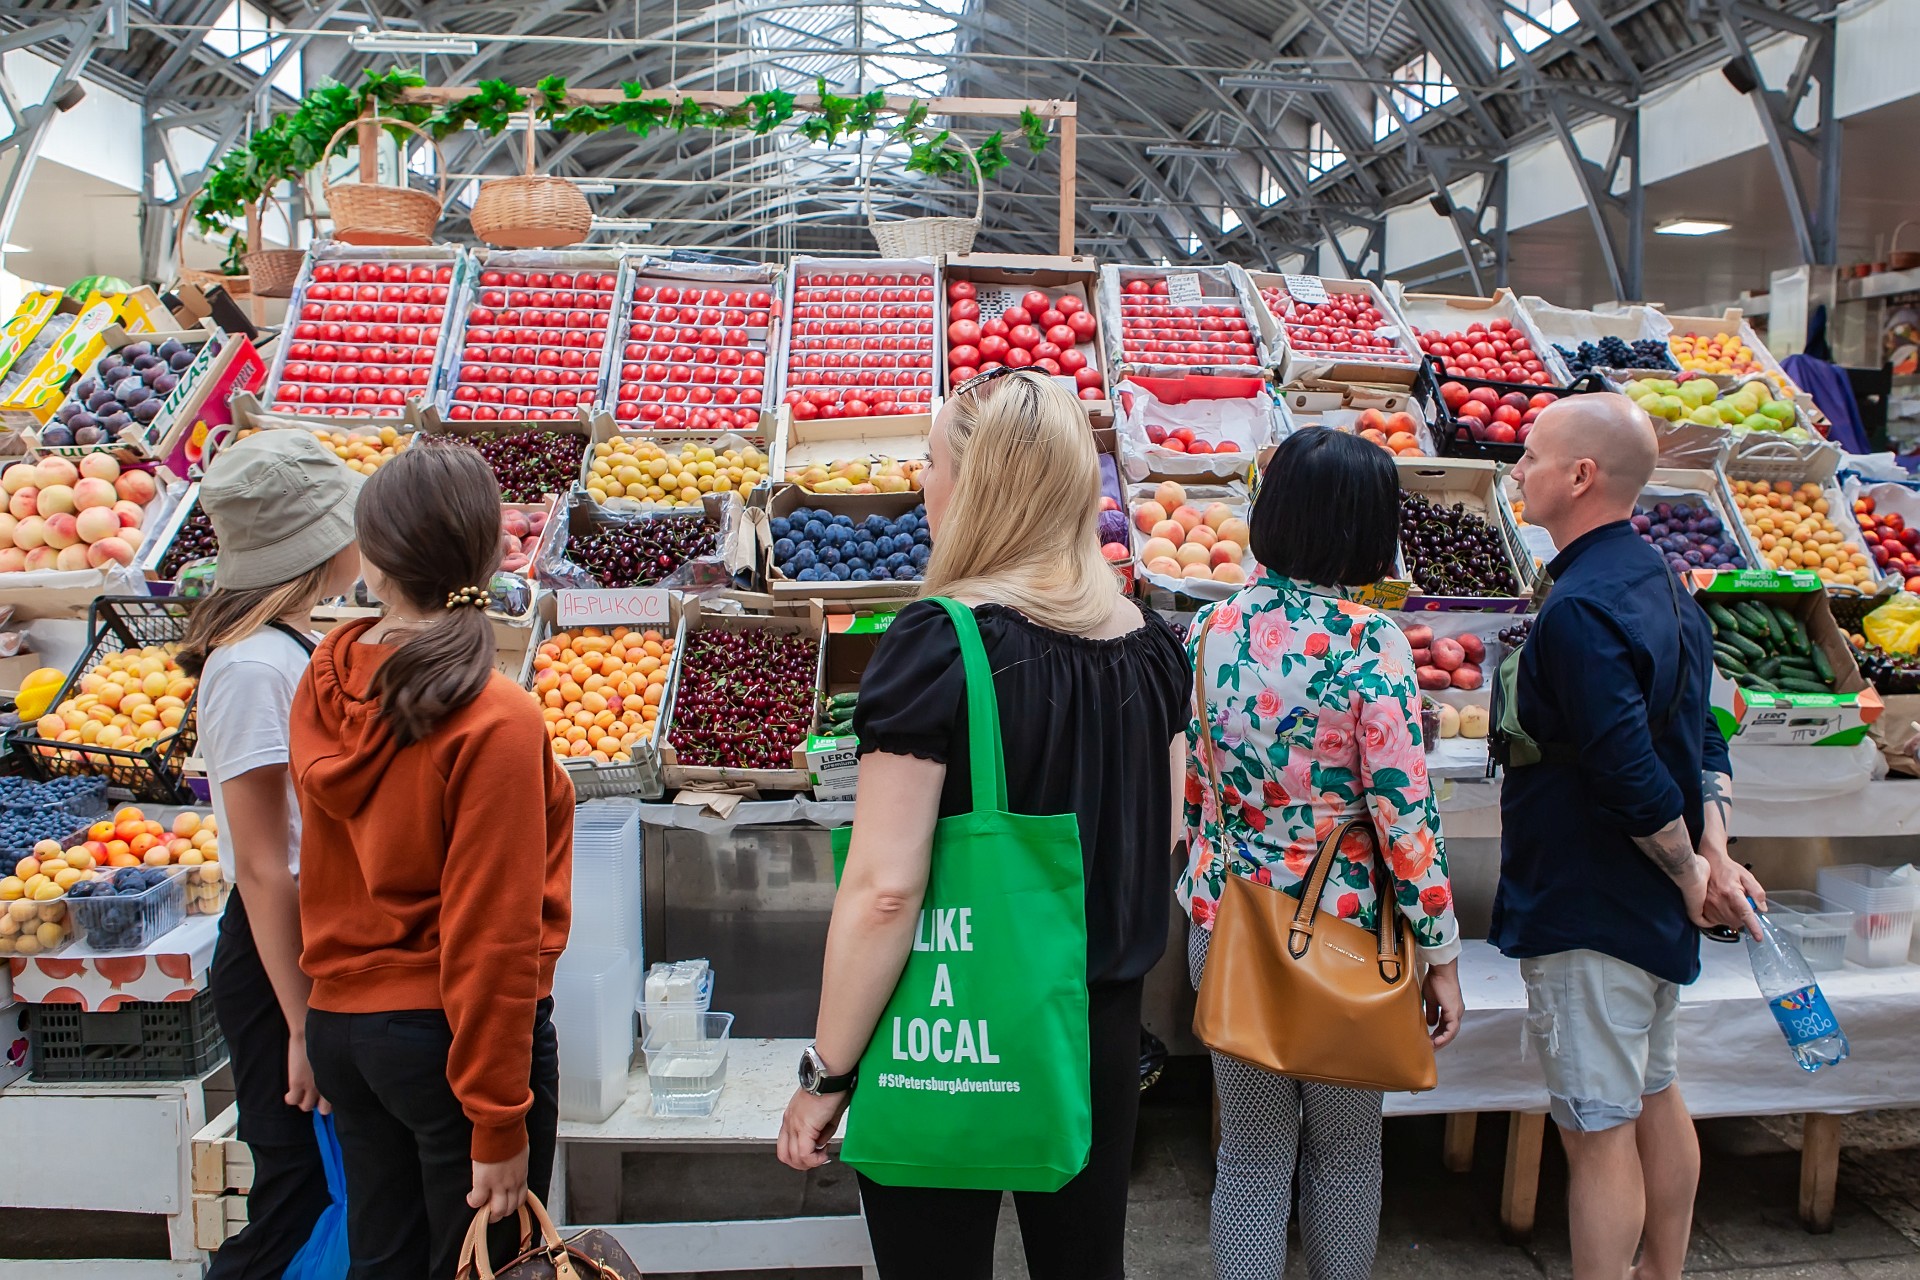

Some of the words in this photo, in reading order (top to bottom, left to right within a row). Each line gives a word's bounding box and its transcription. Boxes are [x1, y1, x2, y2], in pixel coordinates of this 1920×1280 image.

[563, 592, 660, 617] АБРИКОС
[821, 752, 853, 764] LERO
[823, 760, 855, 770] premium
[913, 907, 974, 952] LIKE
[930, 963, 954, 1007] A
[892, 1016, 1000, 1064] LOCAL
[878, 1073, 1021, 1095] #StPetersburgAdventures
